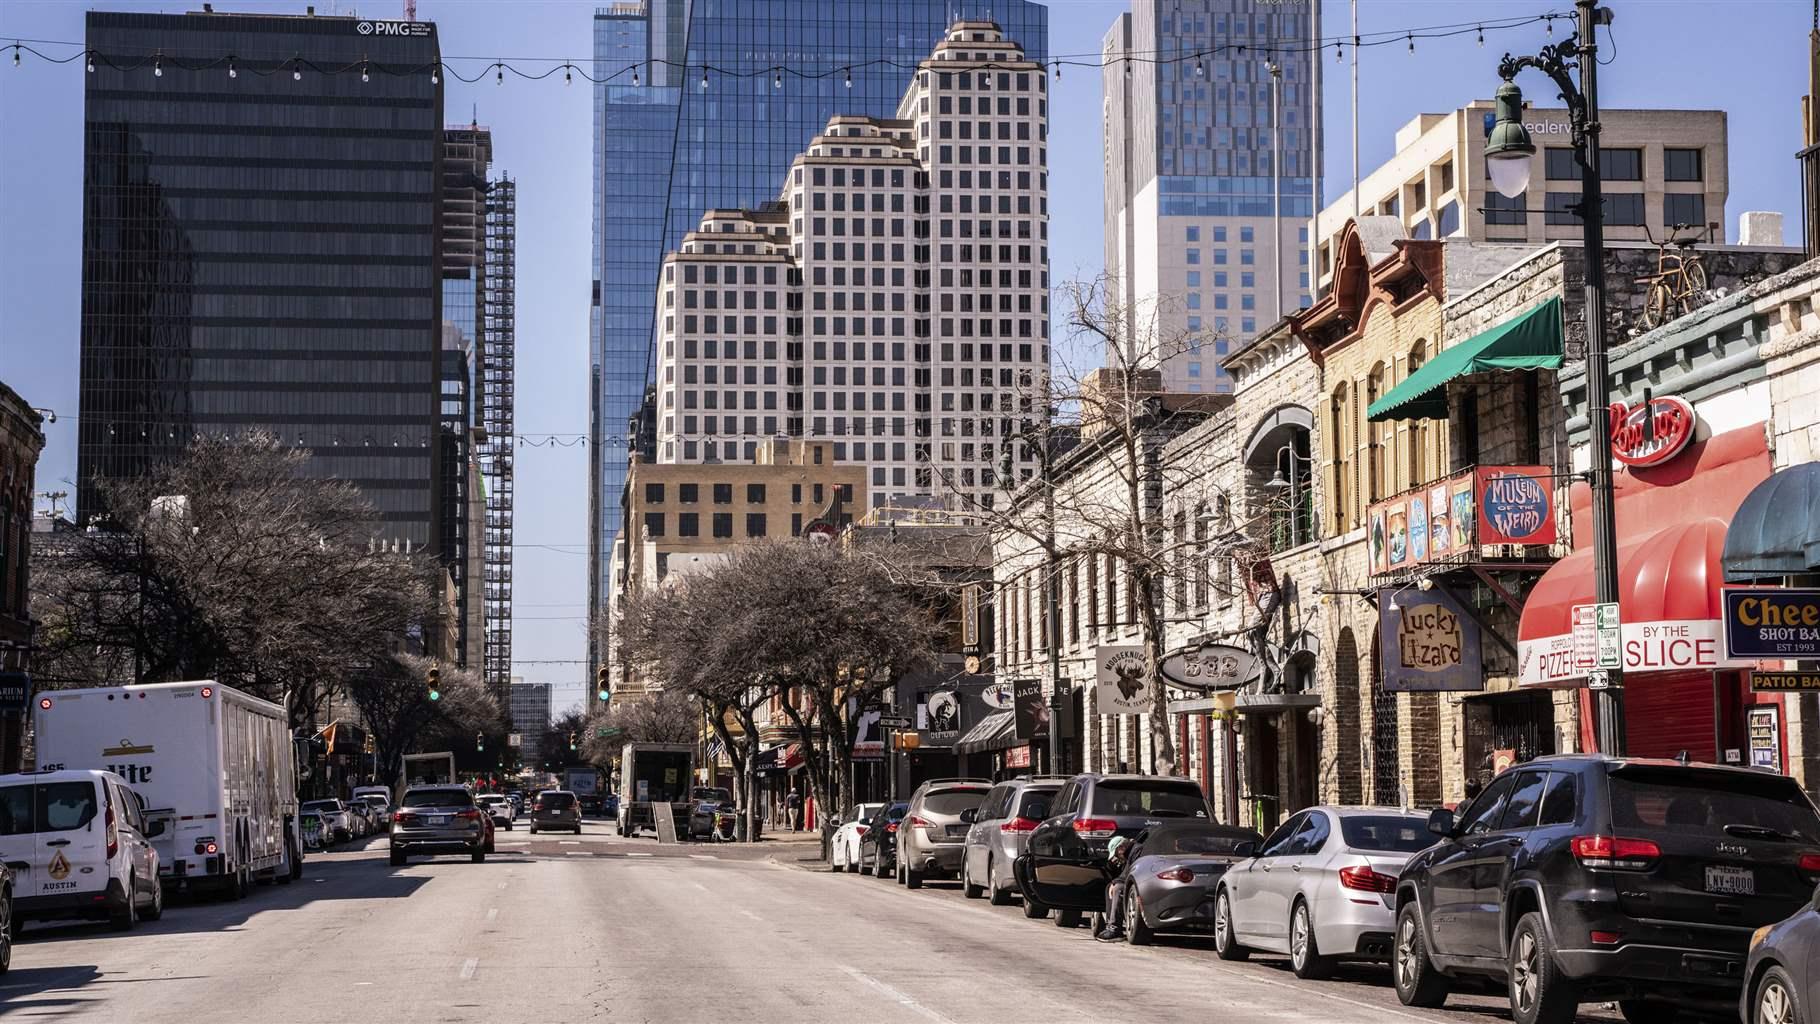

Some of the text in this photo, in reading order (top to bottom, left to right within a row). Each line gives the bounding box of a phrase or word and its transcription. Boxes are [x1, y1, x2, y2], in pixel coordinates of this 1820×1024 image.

[375, 22, 410, 35] PMG
[1491, 471, 1541, 505] MUSEUM
[1494, 510, 1539, 538] WEIRD
[1598, 609, 1603, 626] 2
[1738, 598, 1819, 626] Chee
[1400, 605, 1457, 635] Lucky
[1643, 625, 1689, 637] BY THE
[1759, 627, 1820, 641] SHOT BA
[1400, 631, 1461, 668] Lizard
[1626, 639, 1718, 667] SLICE
[1776, 643, 1815, 652] EST 1993
[1754, 676, 1820, 688] PATIO BA
[1727, 750, 1740, 759] ATM
[1715, 841, 1748, 856] Jeep
[42, 881, 77, 890] AUSTIN
